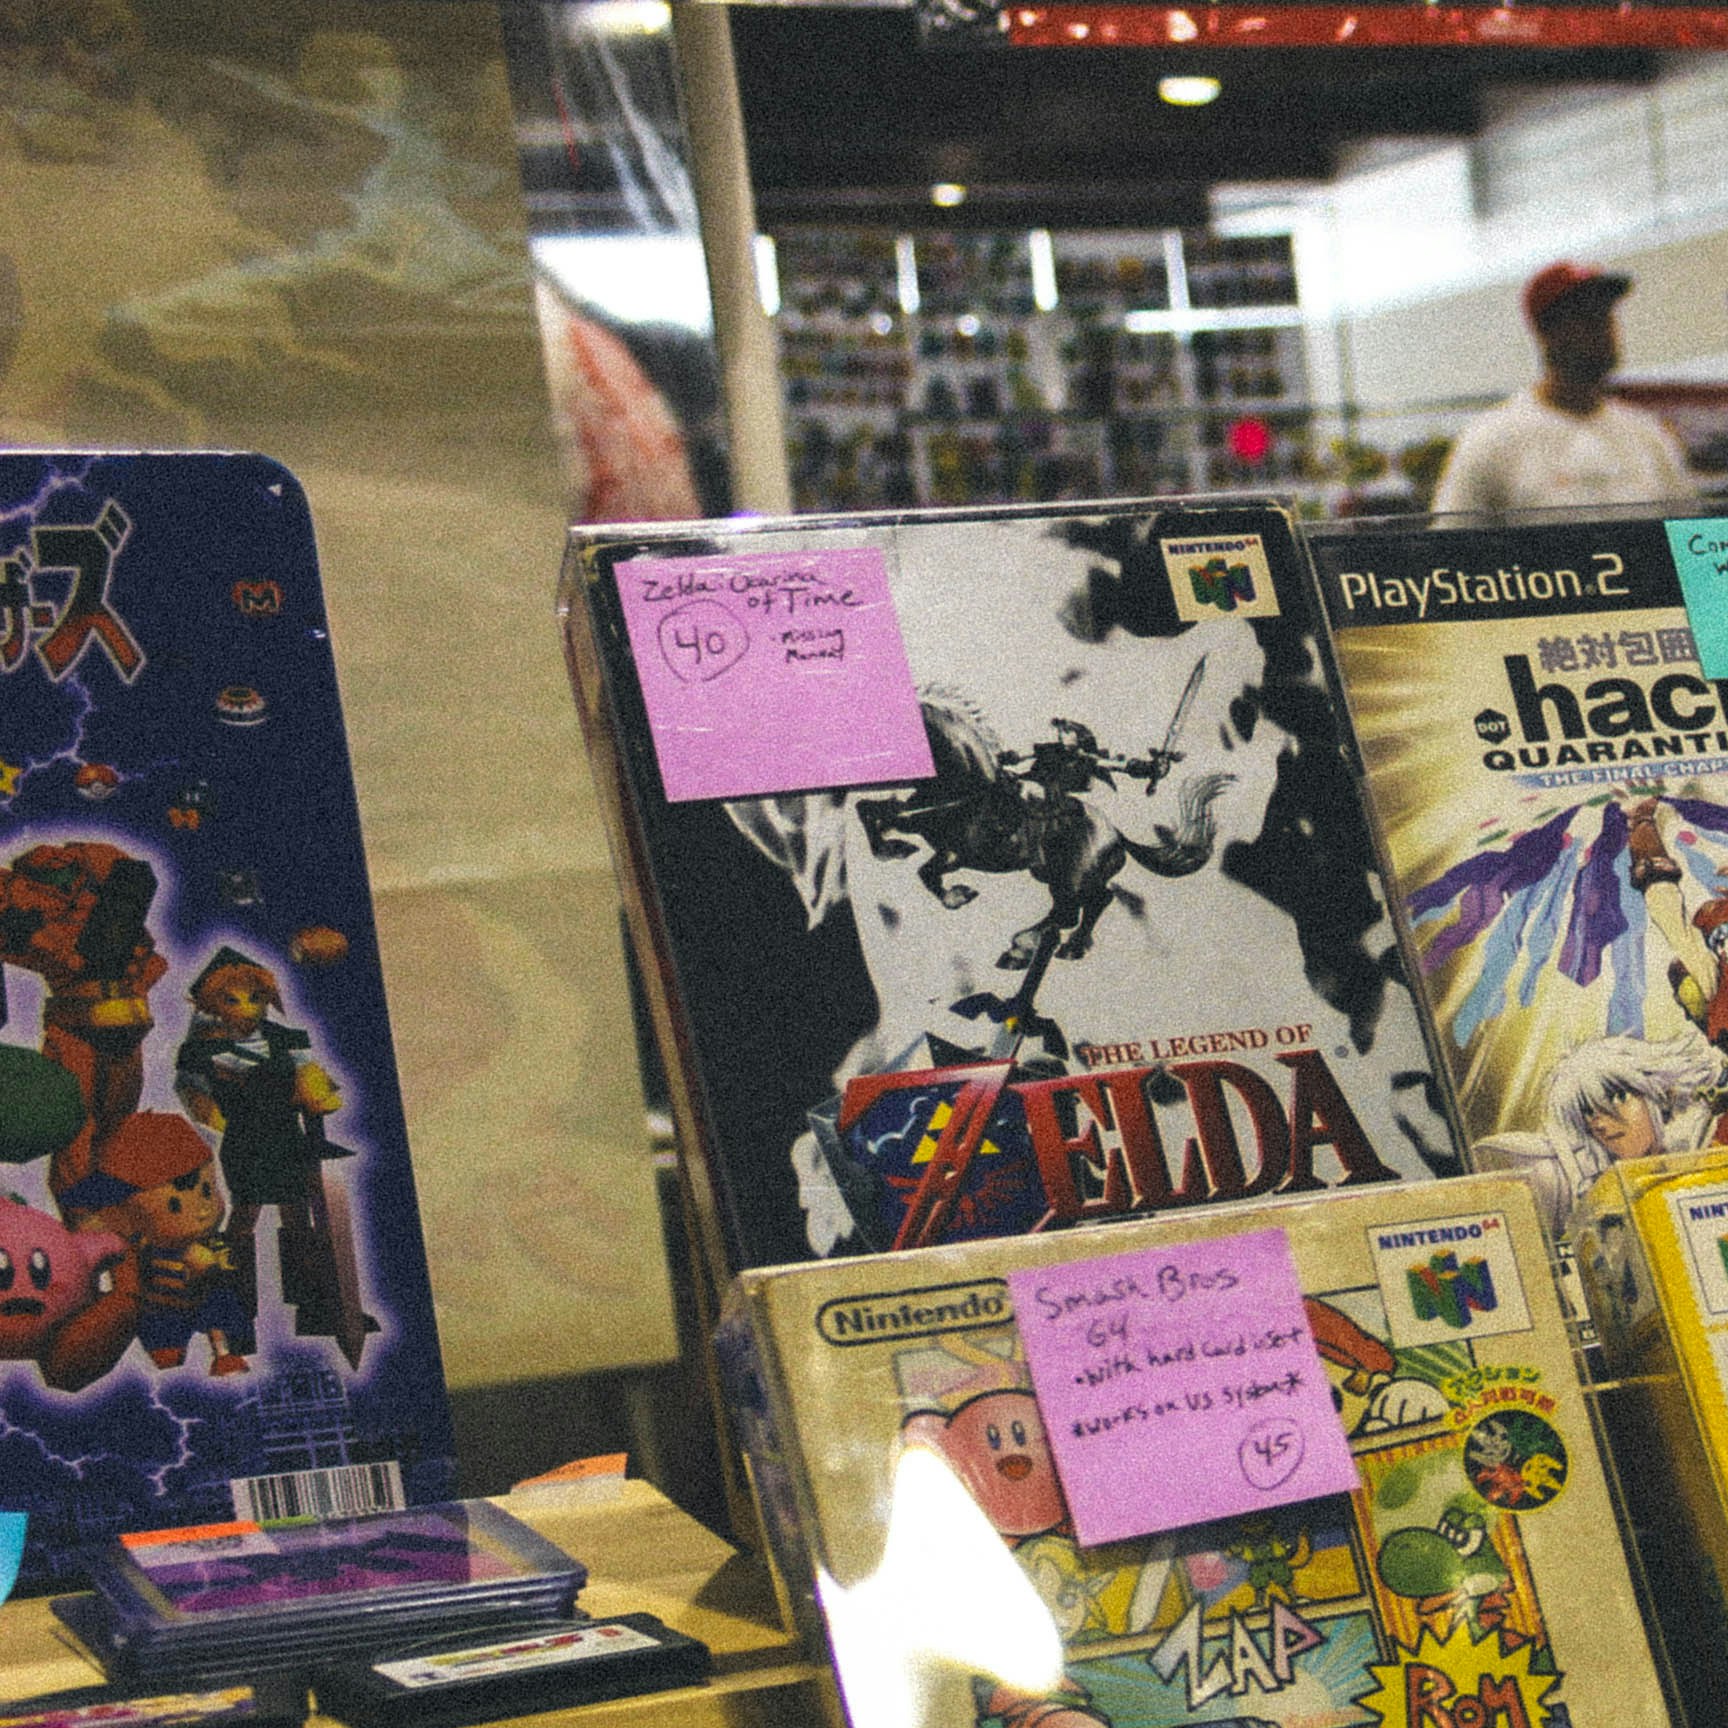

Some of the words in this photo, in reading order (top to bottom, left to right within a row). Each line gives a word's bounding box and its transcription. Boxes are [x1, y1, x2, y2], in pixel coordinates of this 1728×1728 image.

[778, 586, 862, 616] Time
[1341, 560, 1587, 617] PlayStation
[674, 625, 728, 666] 40
[1540, 772, 1583, 789] THE
[1593, 765, 1660, 784] FINAL
[1087, 1041, 1143, 1069] THE
[1149, 1029, 1264, 1058] LEGEND
[1274, 1022, 1314, 1046] OF
[834, 1047, 1402, 1254] ZELDA
[1377, 1224, 1483, 1251] NINTENDO
[832, 1289, 1006, 1336] Nintendo
[1035, 1275, 1150, 1321] Smash
[1156, 1264, 1240, 1301] Bros
[1085, 1313, 1132, 1348] 64
[1153, 1399, 1177, 1417] on
[1186, 1390, 1214, 1414] US
[1252, 1430, 1295, 1468] 45
[1149, 1602, 1328, 1712] ZAP
